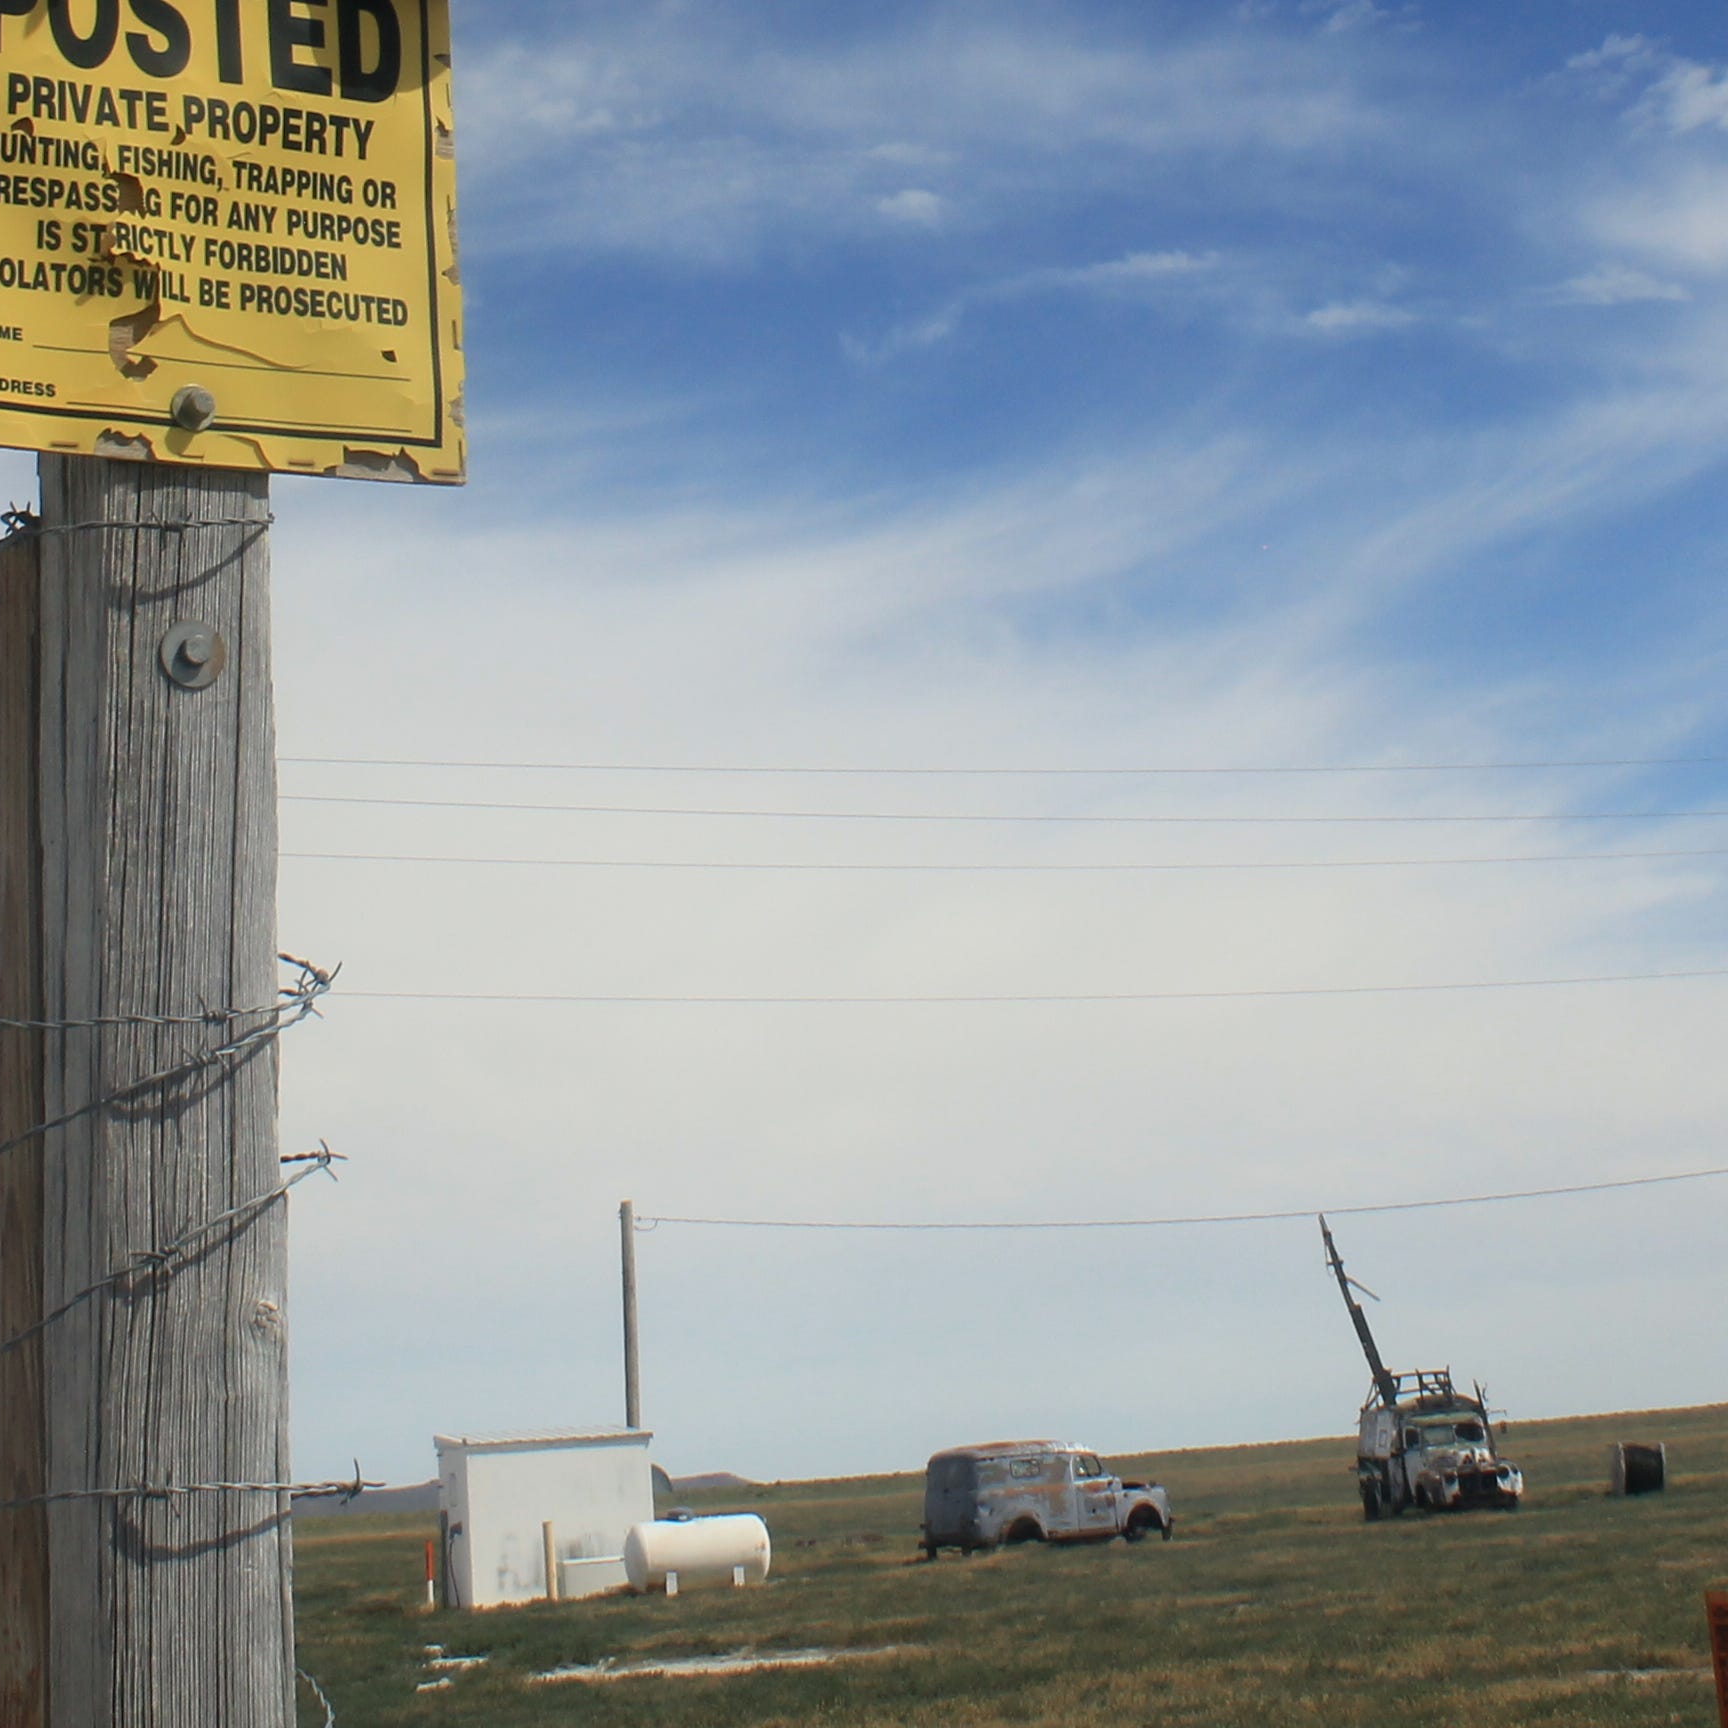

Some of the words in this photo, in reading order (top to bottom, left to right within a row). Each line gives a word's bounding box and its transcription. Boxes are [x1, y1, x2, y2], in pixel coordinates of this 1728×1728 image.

[8, 73, 168, 132] PRIVATE
[183, 94, 375, 160] PROPERTY
[118, 145, 223, 192] FISHING,
[232, 160, 353, 204] TRAPPING
[362, 178, 397, 209] OR
[170, 191, 218, 226] FOR
[227, 201, 277, 233] ANY
[287, 208, 402, 248] PURPOSE
[36, 220, 61, 251] IS
[71, 222, 196, 263] STRICTLY
[204, 238, 348, 281] FORBIDDEN
[133, 269, 190, 303] WILL
[199, 277, 230, 309] BE
[240, 282, 408, 326] PROSECUTED
